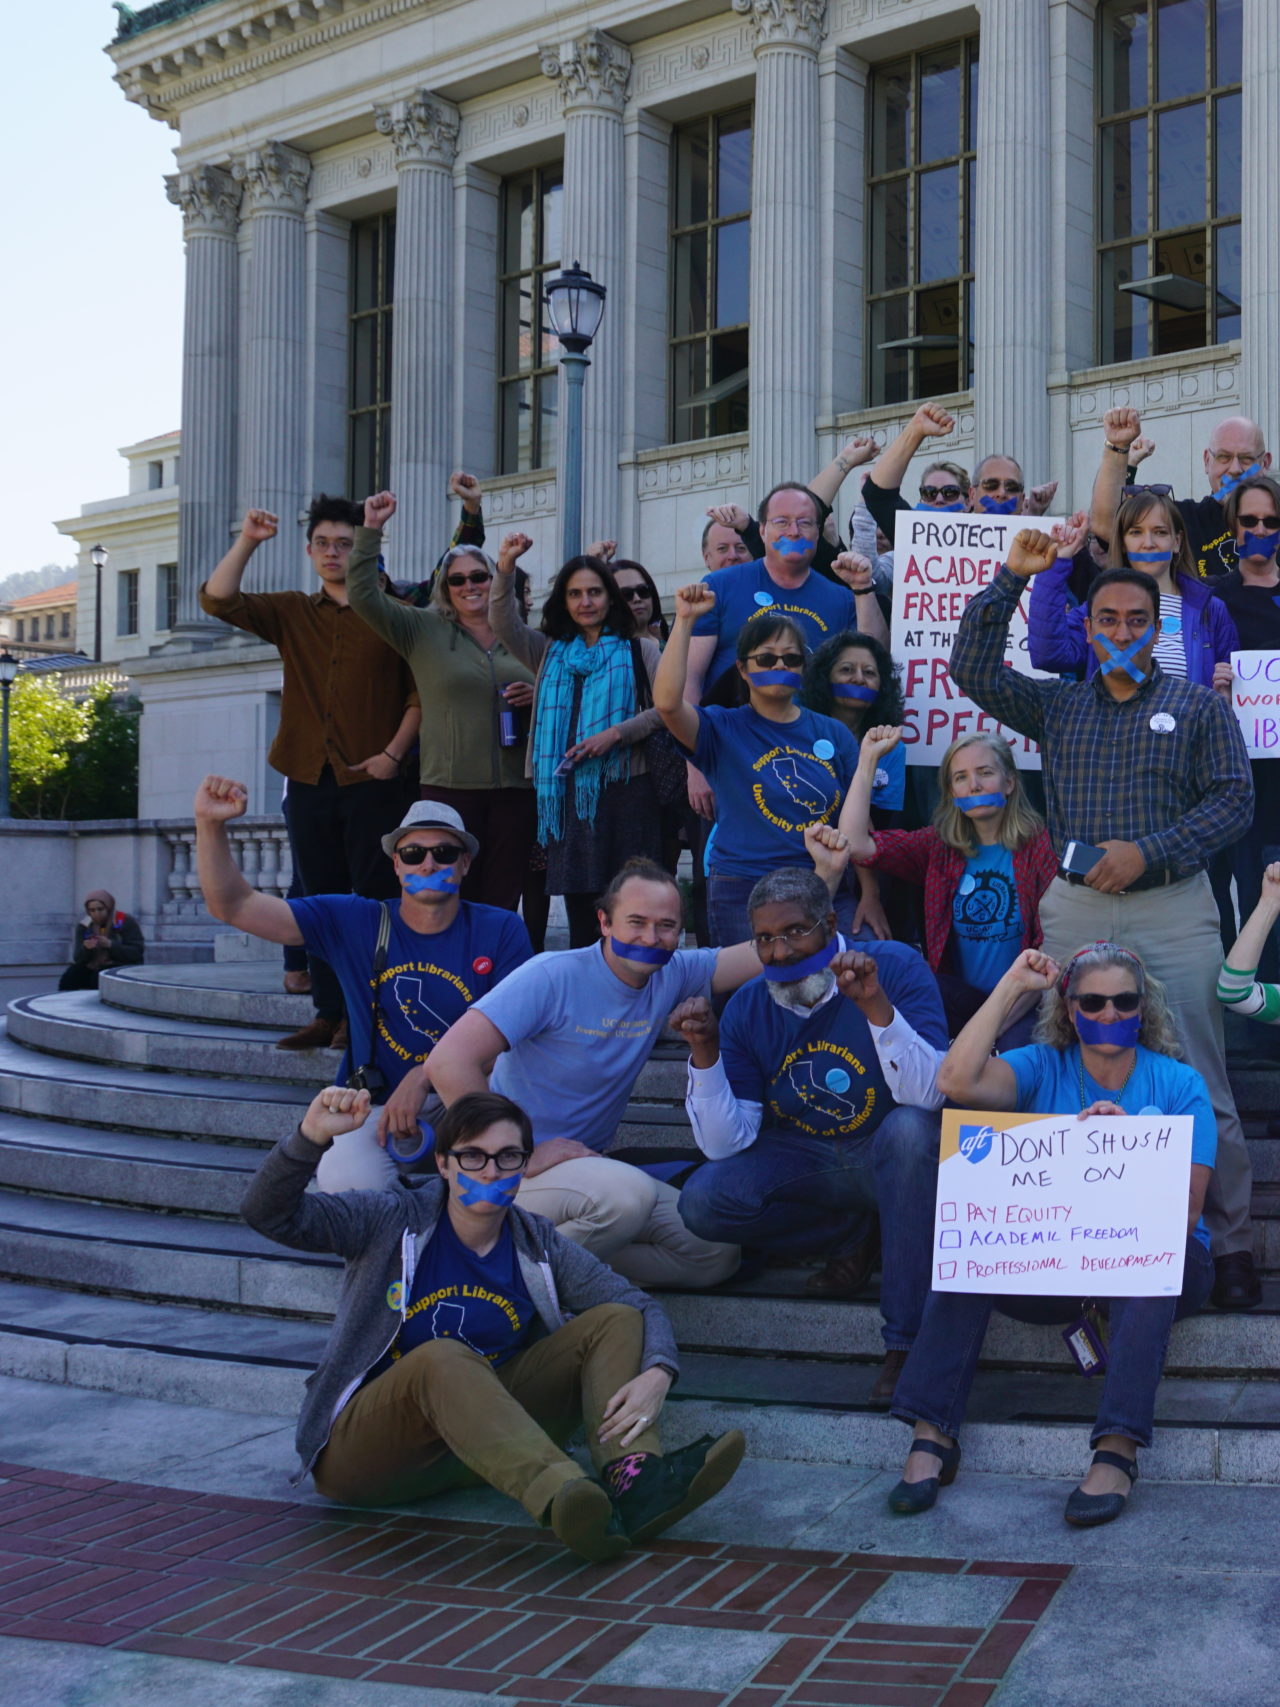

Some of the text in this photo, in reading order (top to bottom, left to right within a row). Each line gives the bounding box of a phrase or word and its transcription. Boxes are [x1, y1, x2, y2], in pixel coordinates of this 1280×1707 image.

[911, 521, 1007, 552] PROTECT
[903, 554, 1033, 592] ACADE
[903, 592, 1029, 624] FREE
[904, 630, 924, 647] AT
[417, 961, 474, 1003] Librarians
[960, 1126, 999, 1160] aft
[1000, 1127, 1173, 1167] DON'T SHUSH
[1012, 1163, 1126, 1187] ME ON
[966, 1202, 1074, 1224] PAY EQUITY
[969, 1226, 1140, 1247] ACADEMIC FREEDOM
[1080, 1251, 1177, 1272] DEVELOPMENT
[462, 1284, 522, 1332] Librarians
